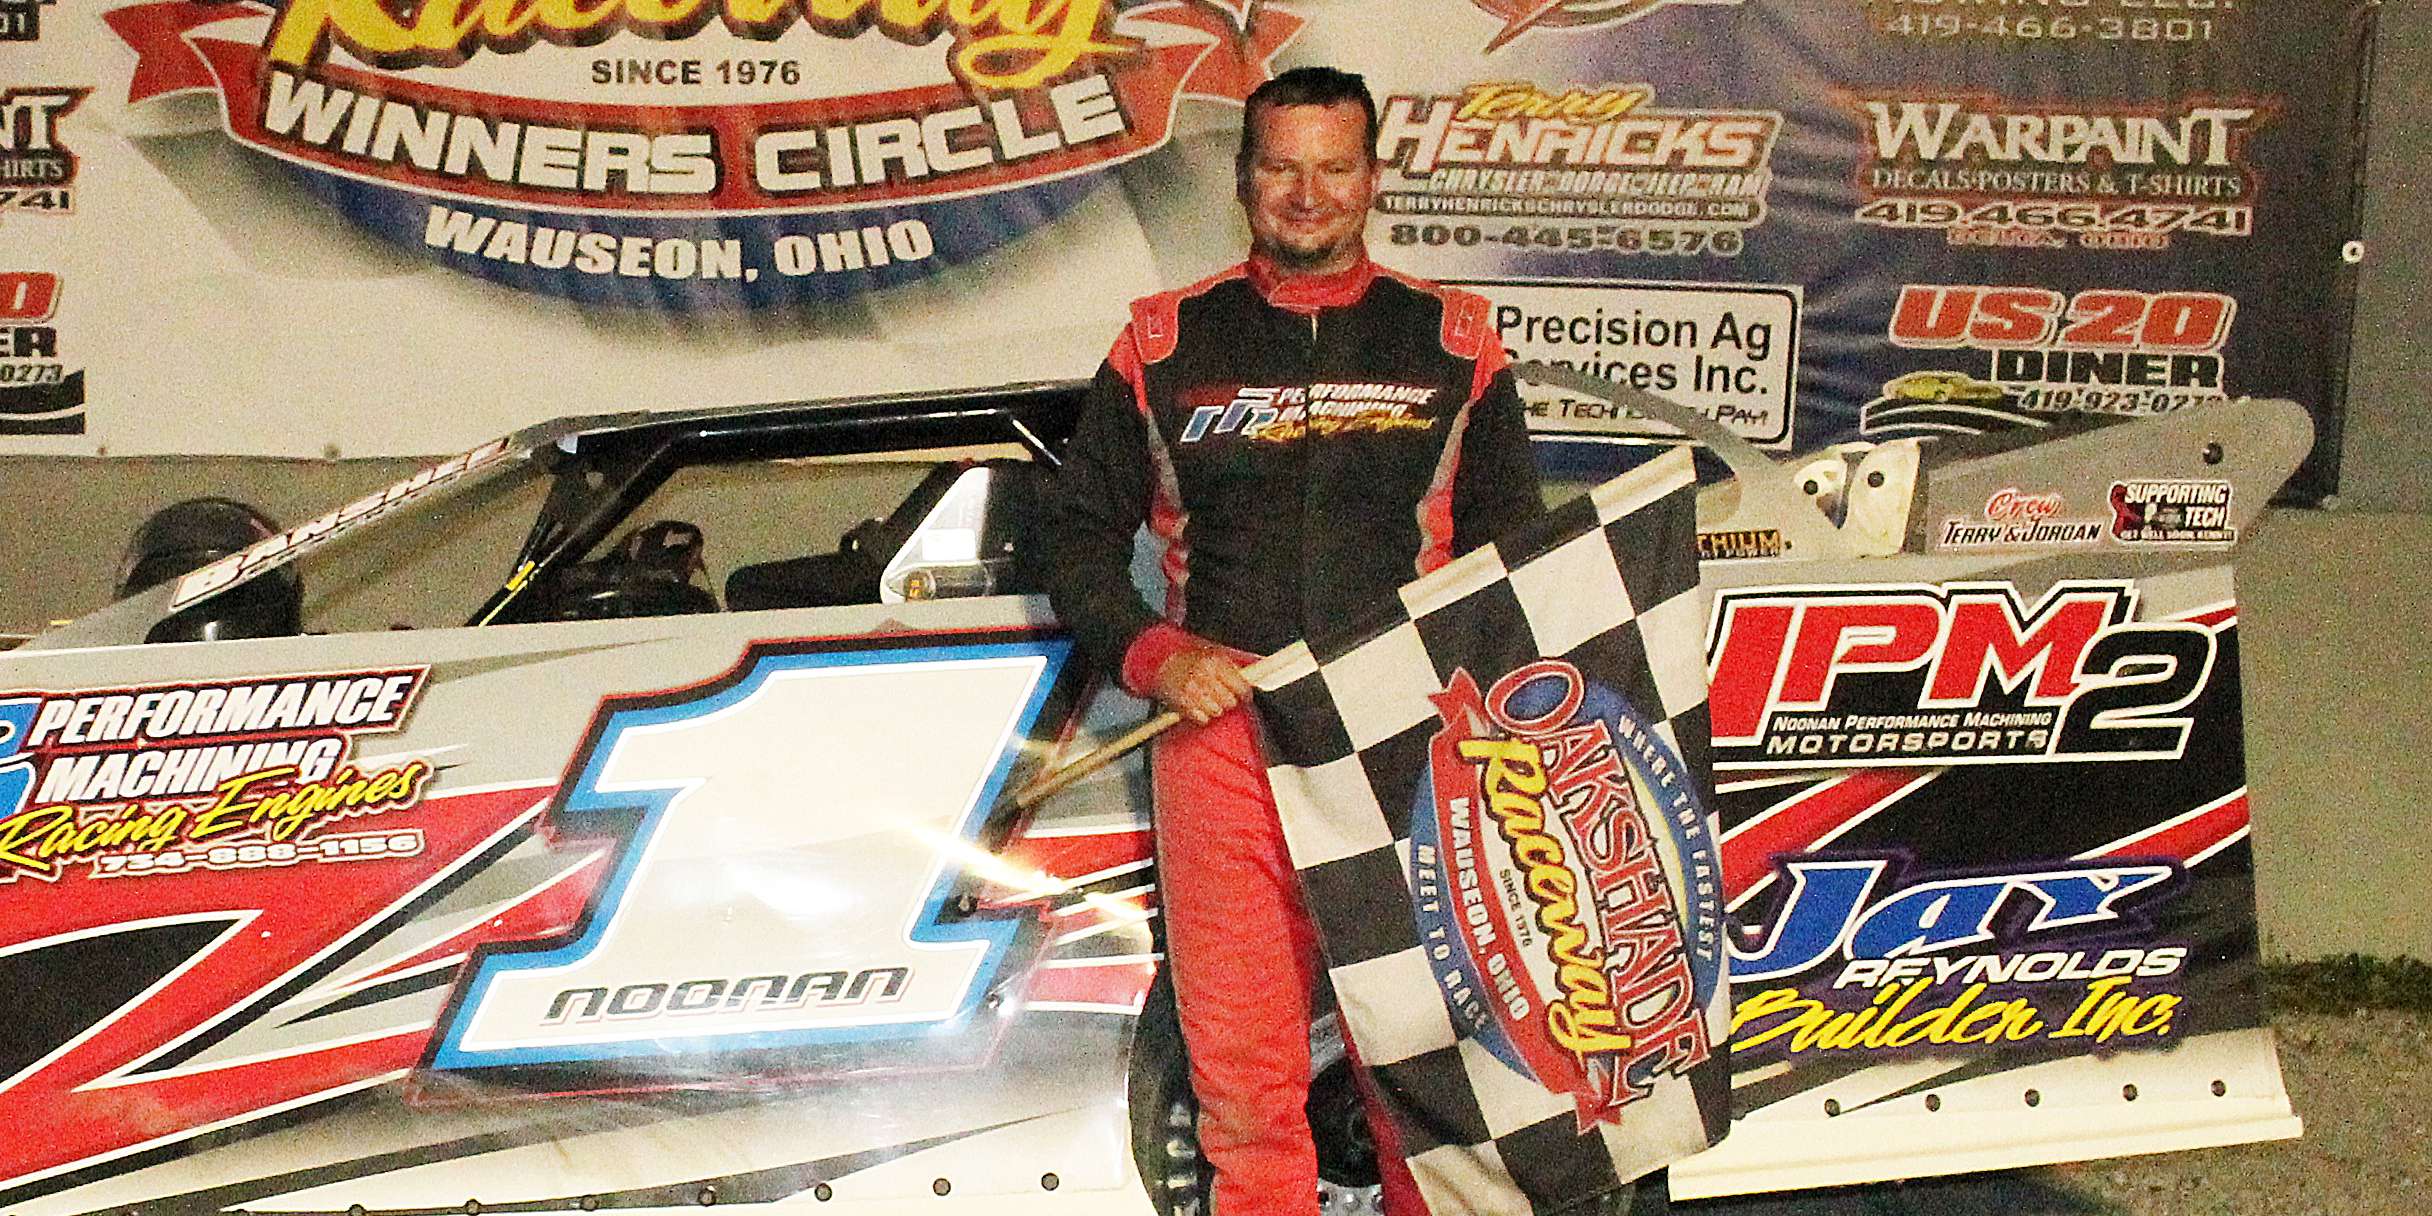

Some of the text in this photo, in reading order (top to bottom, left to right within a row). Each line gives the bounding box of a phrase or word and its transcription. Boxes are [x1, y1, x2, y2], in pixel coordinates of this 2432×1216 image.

[592, 60, 800, 86] SINCE 1976
[1457, 82, 1650, 121] Terry
[264, 70, 1129, 194] WINNERS CIRCLE
[1376, 97, 1764, 173] HENRICKS
[1867, 101, 2254, 166] WARPAINT
[2099, 173, 2117, 193] &
[2129, 171, 2242, 197] T-SHIRTS
[424, 204, 935, 283] WAUSEON, OHIO
[1391, 222, 1741, 251] 800-445-6576
[1496, 305, 1772, 361] Precision Ag
[1892, 285, 2236, 352] US 20
[1695, 354, 1768, 394] Inc.
[1997, 351, 2219, 388] DINER
[2125, 483, 2229, 504] SUPPORTING
[2185, 505, 2225, 527] TECH
[1944, 520, 2001, 544] TERRY
[2022, 516, 2101, 543] JORDAN
[26, 675, 414, 747] PERFORMANCE
[1773, 711, 2052, 732] NOONAN PERFORMANCE MACHINING
[35, 738, 342, 804] MACHINING
[1766, 730, 2049, 755] MOTORSPORTS
[0, 763, 423, 873] Racing Engines
[1619, 714, 1716, 962] WHERE THE FASTEST
[440, 645, 1070, 1060] 1
[1485, 659, 1712, 1107] OAKSHADE
[1450, 797, 1531, 1021] WAUSEON, OHIO
[1458, 738, 1633, 1052] Raceway
[1500, 868, 1522, 918] SINCE
[1416, 844, 1491, 1032] MEET TO RACE
[1834, 948, 2189, 989] REYNOLDS
[545, 966, 912, 1024] NOONAN
[1731, 975, 2184, 1053] Builder Inc.
